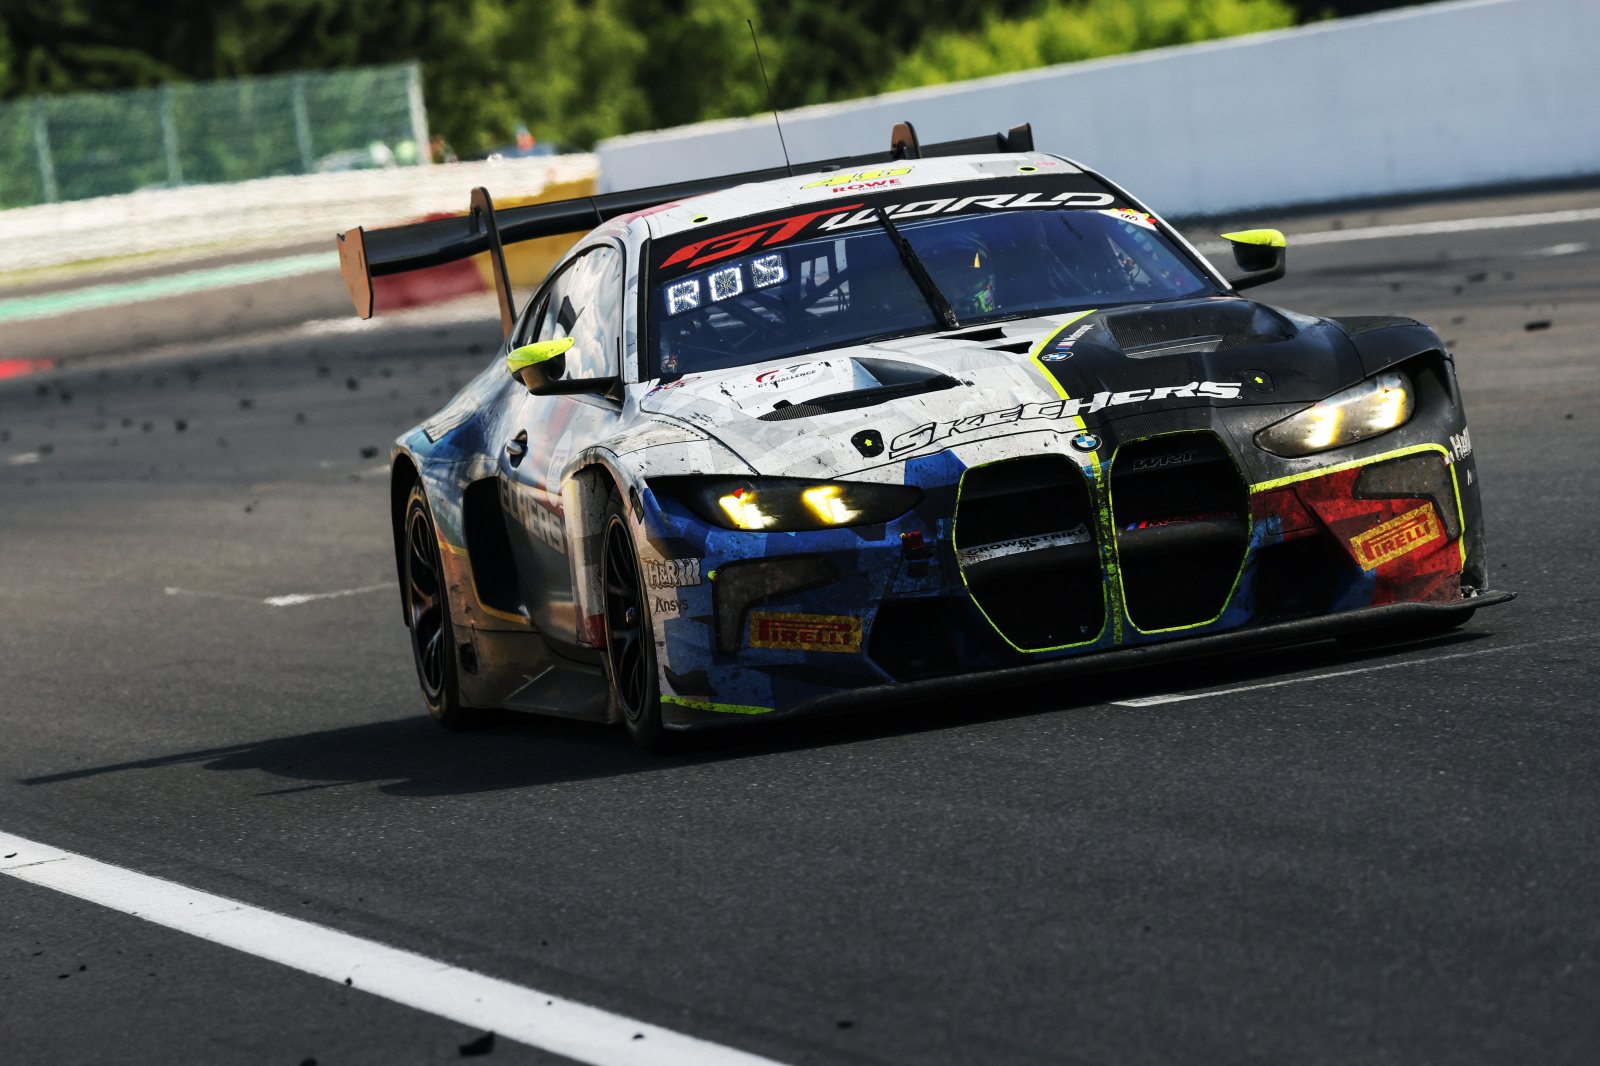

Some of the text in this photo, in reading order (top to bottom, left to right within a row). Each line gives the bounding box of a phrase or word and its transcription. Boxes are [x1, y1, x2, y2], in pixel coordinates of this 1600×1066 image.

[832, 179, 900, 193] ROWE
[817, 192, 1115, 231] WORLD
[668, 255, 785, 316] ROS
[770, 370, 817, 385] CHALLENGE
[889, 381, 1242, 460] SKECHERS
[1133, 451, 1198, 471] WRT
[967, 526, 1088, 555] CROWDSTRIKE
[1360, 514, 1432, 562] PIRELLI
[647, 560, 680, 589] H&R
[655, 596, 688, 614] Ansys
[758, 619, 853, 645] PIRELLI
